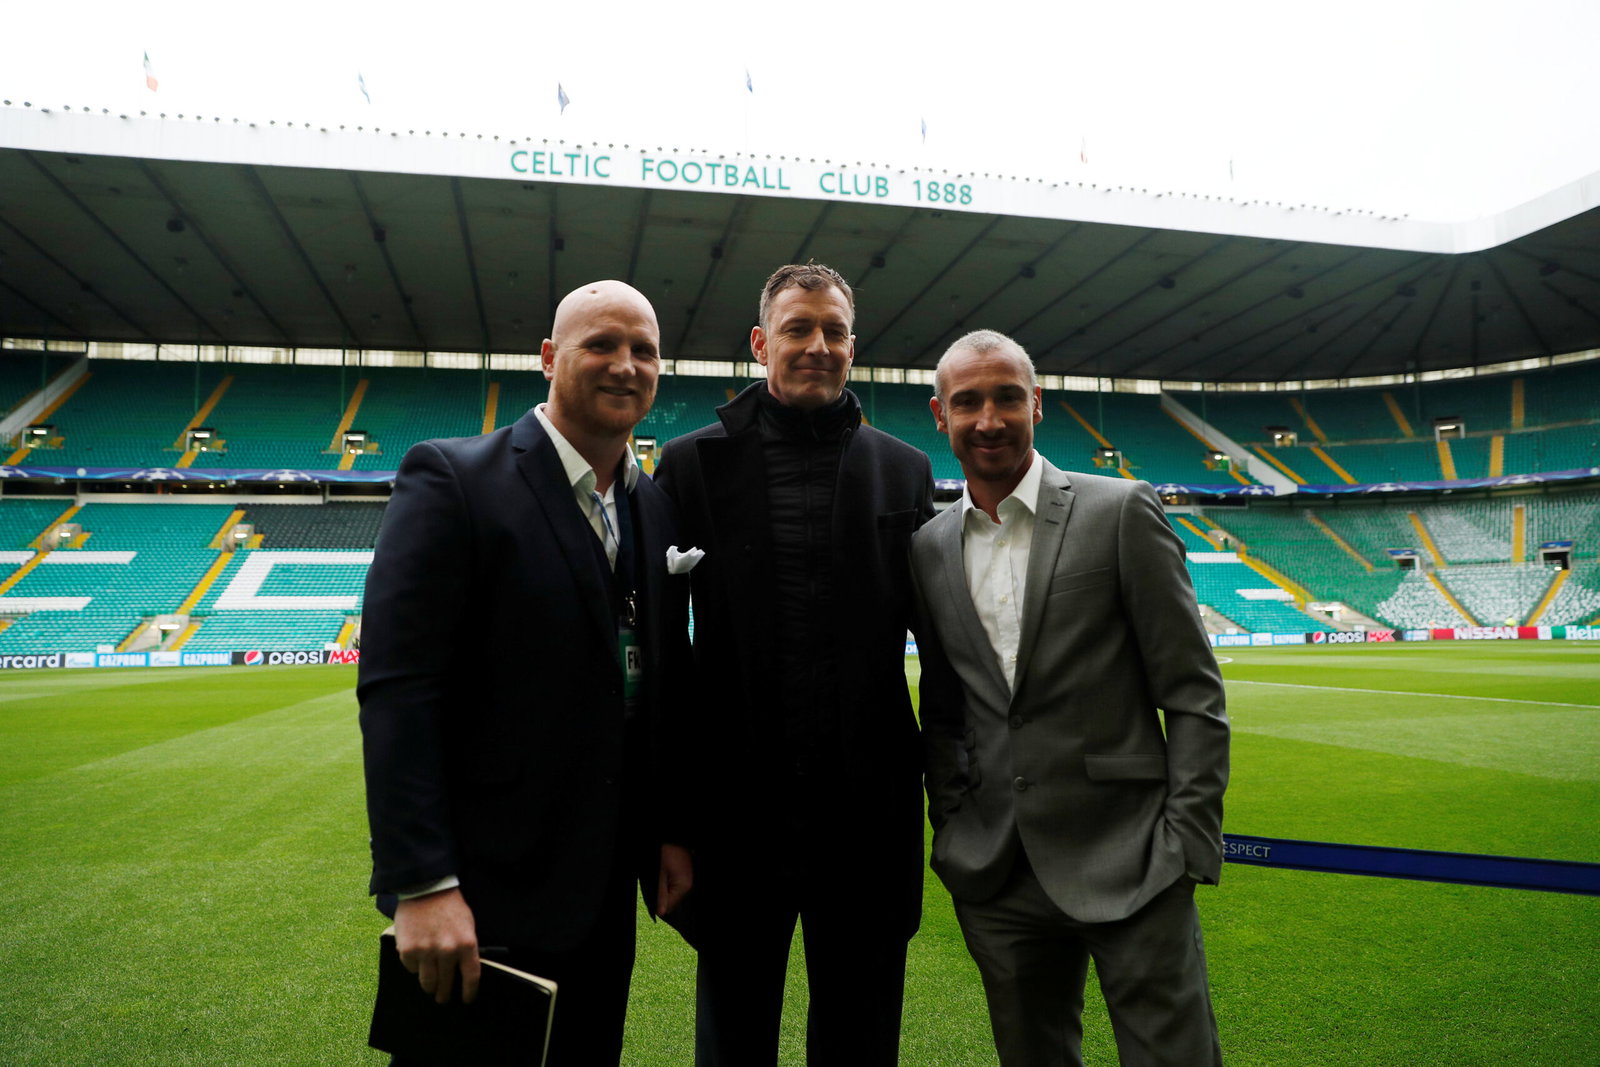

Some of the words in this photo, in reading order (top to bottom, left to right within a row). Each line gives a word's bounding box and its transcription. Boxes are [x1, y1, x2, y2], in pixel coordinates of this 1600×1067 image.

[510, 150, 612, 178] CELTIC
[642, 158, 791, 191] FOOTBALL
[819, 171, 889, 198] CLUB
[912, 179, 973, 205] 1888
[1328, 631, 1365, 643] pepsi
[1453, 627, 1518, 640] NISSAN
[0, 653, 60, 669] rcard
[98, 653, 147, 667] GAZPROM
[182, 652, 230, 666] GAZPROM
[268, 650, 324, 665] pepsi
